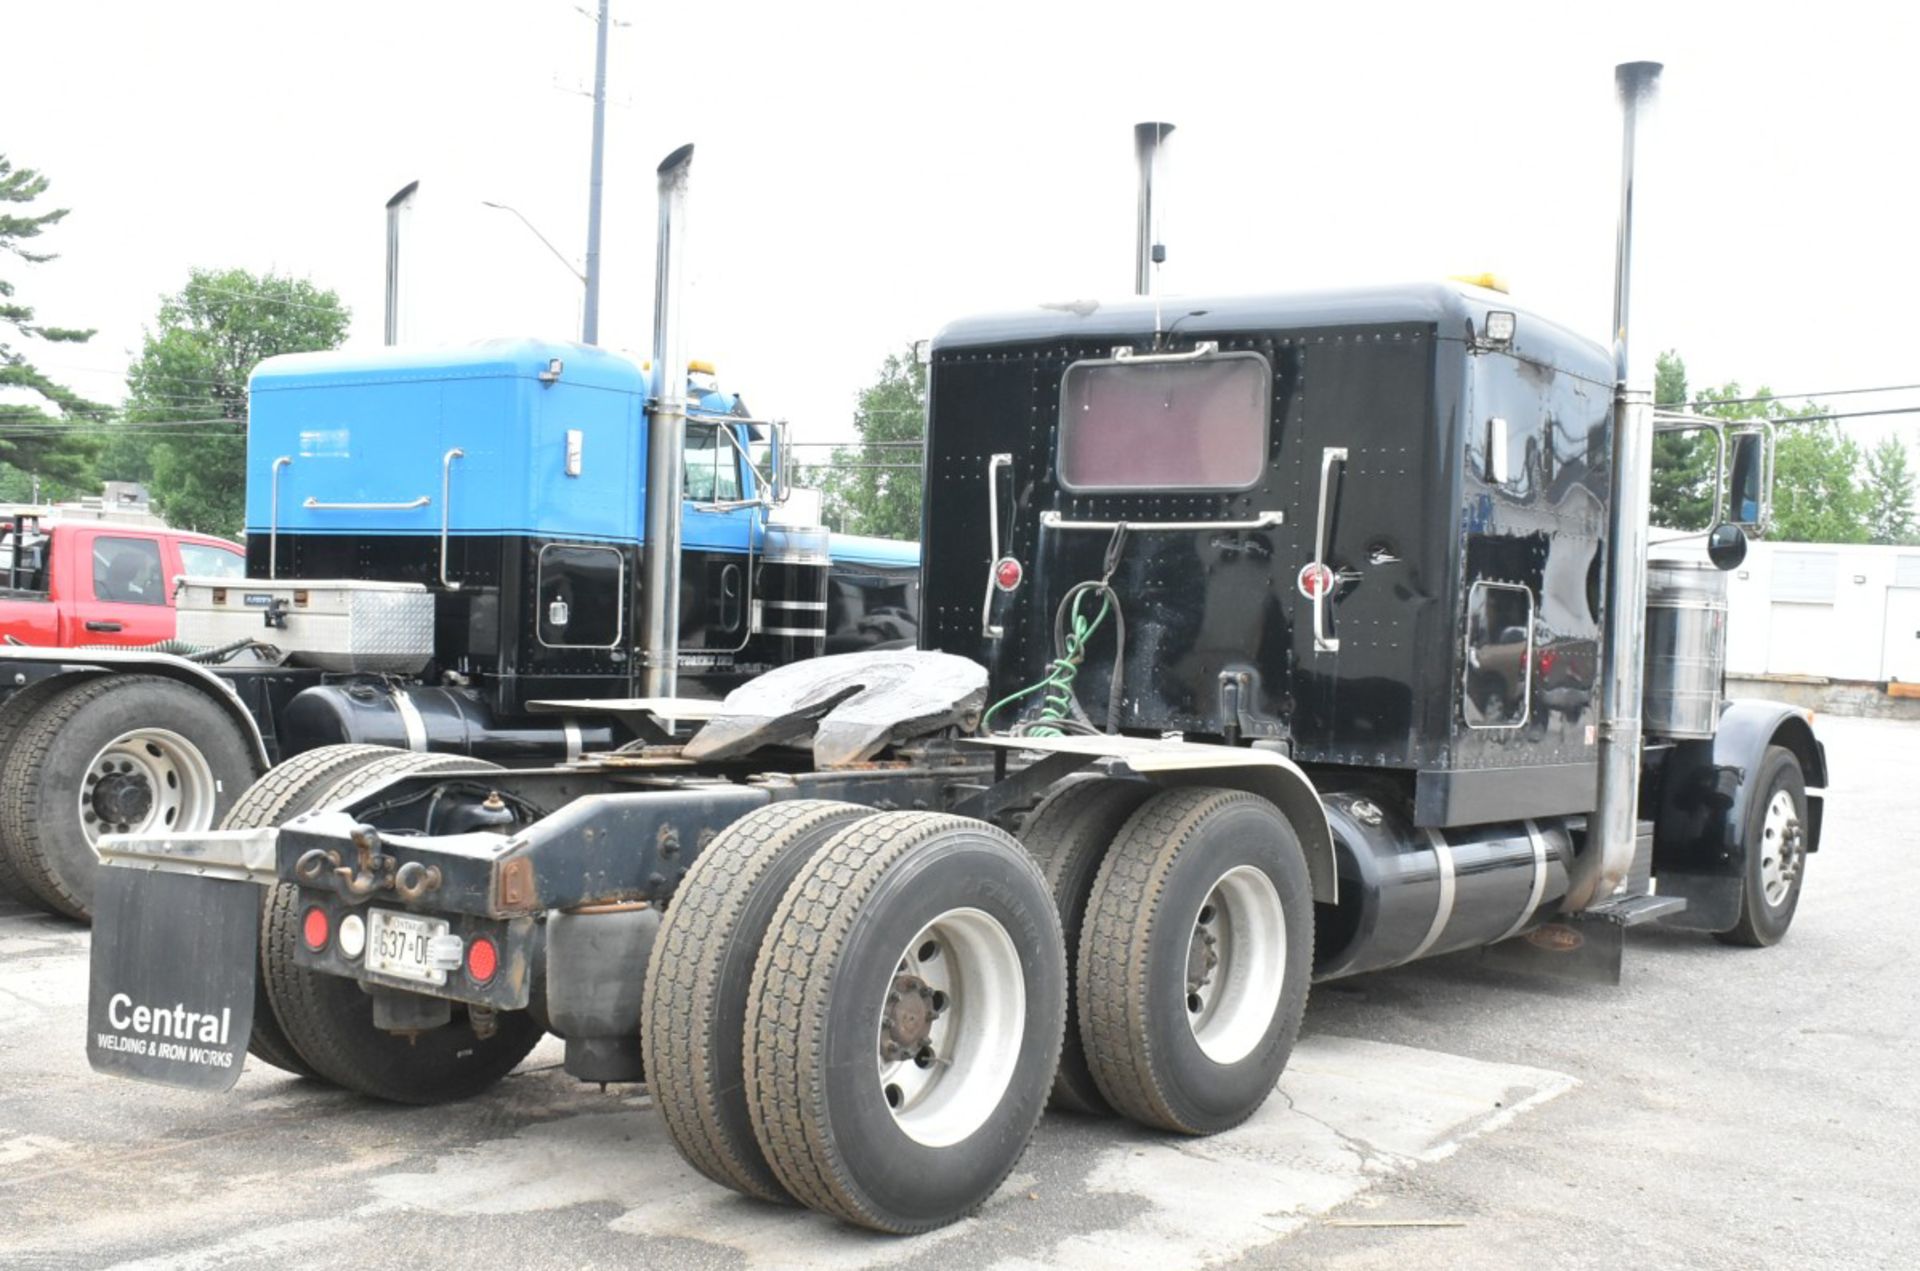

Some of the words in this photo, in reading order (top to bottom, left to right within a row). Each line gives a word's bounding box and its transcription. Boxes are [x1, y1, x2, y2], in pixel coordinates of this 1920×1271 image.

[108, 993, 231, 1045] Central
[97, 1033, 147, 1055] WELDING
[147, 1041, 157, 1057] &
[158, 1043, 188, 1061] IRON
[189, 1047, 234, 1068] WORKS
